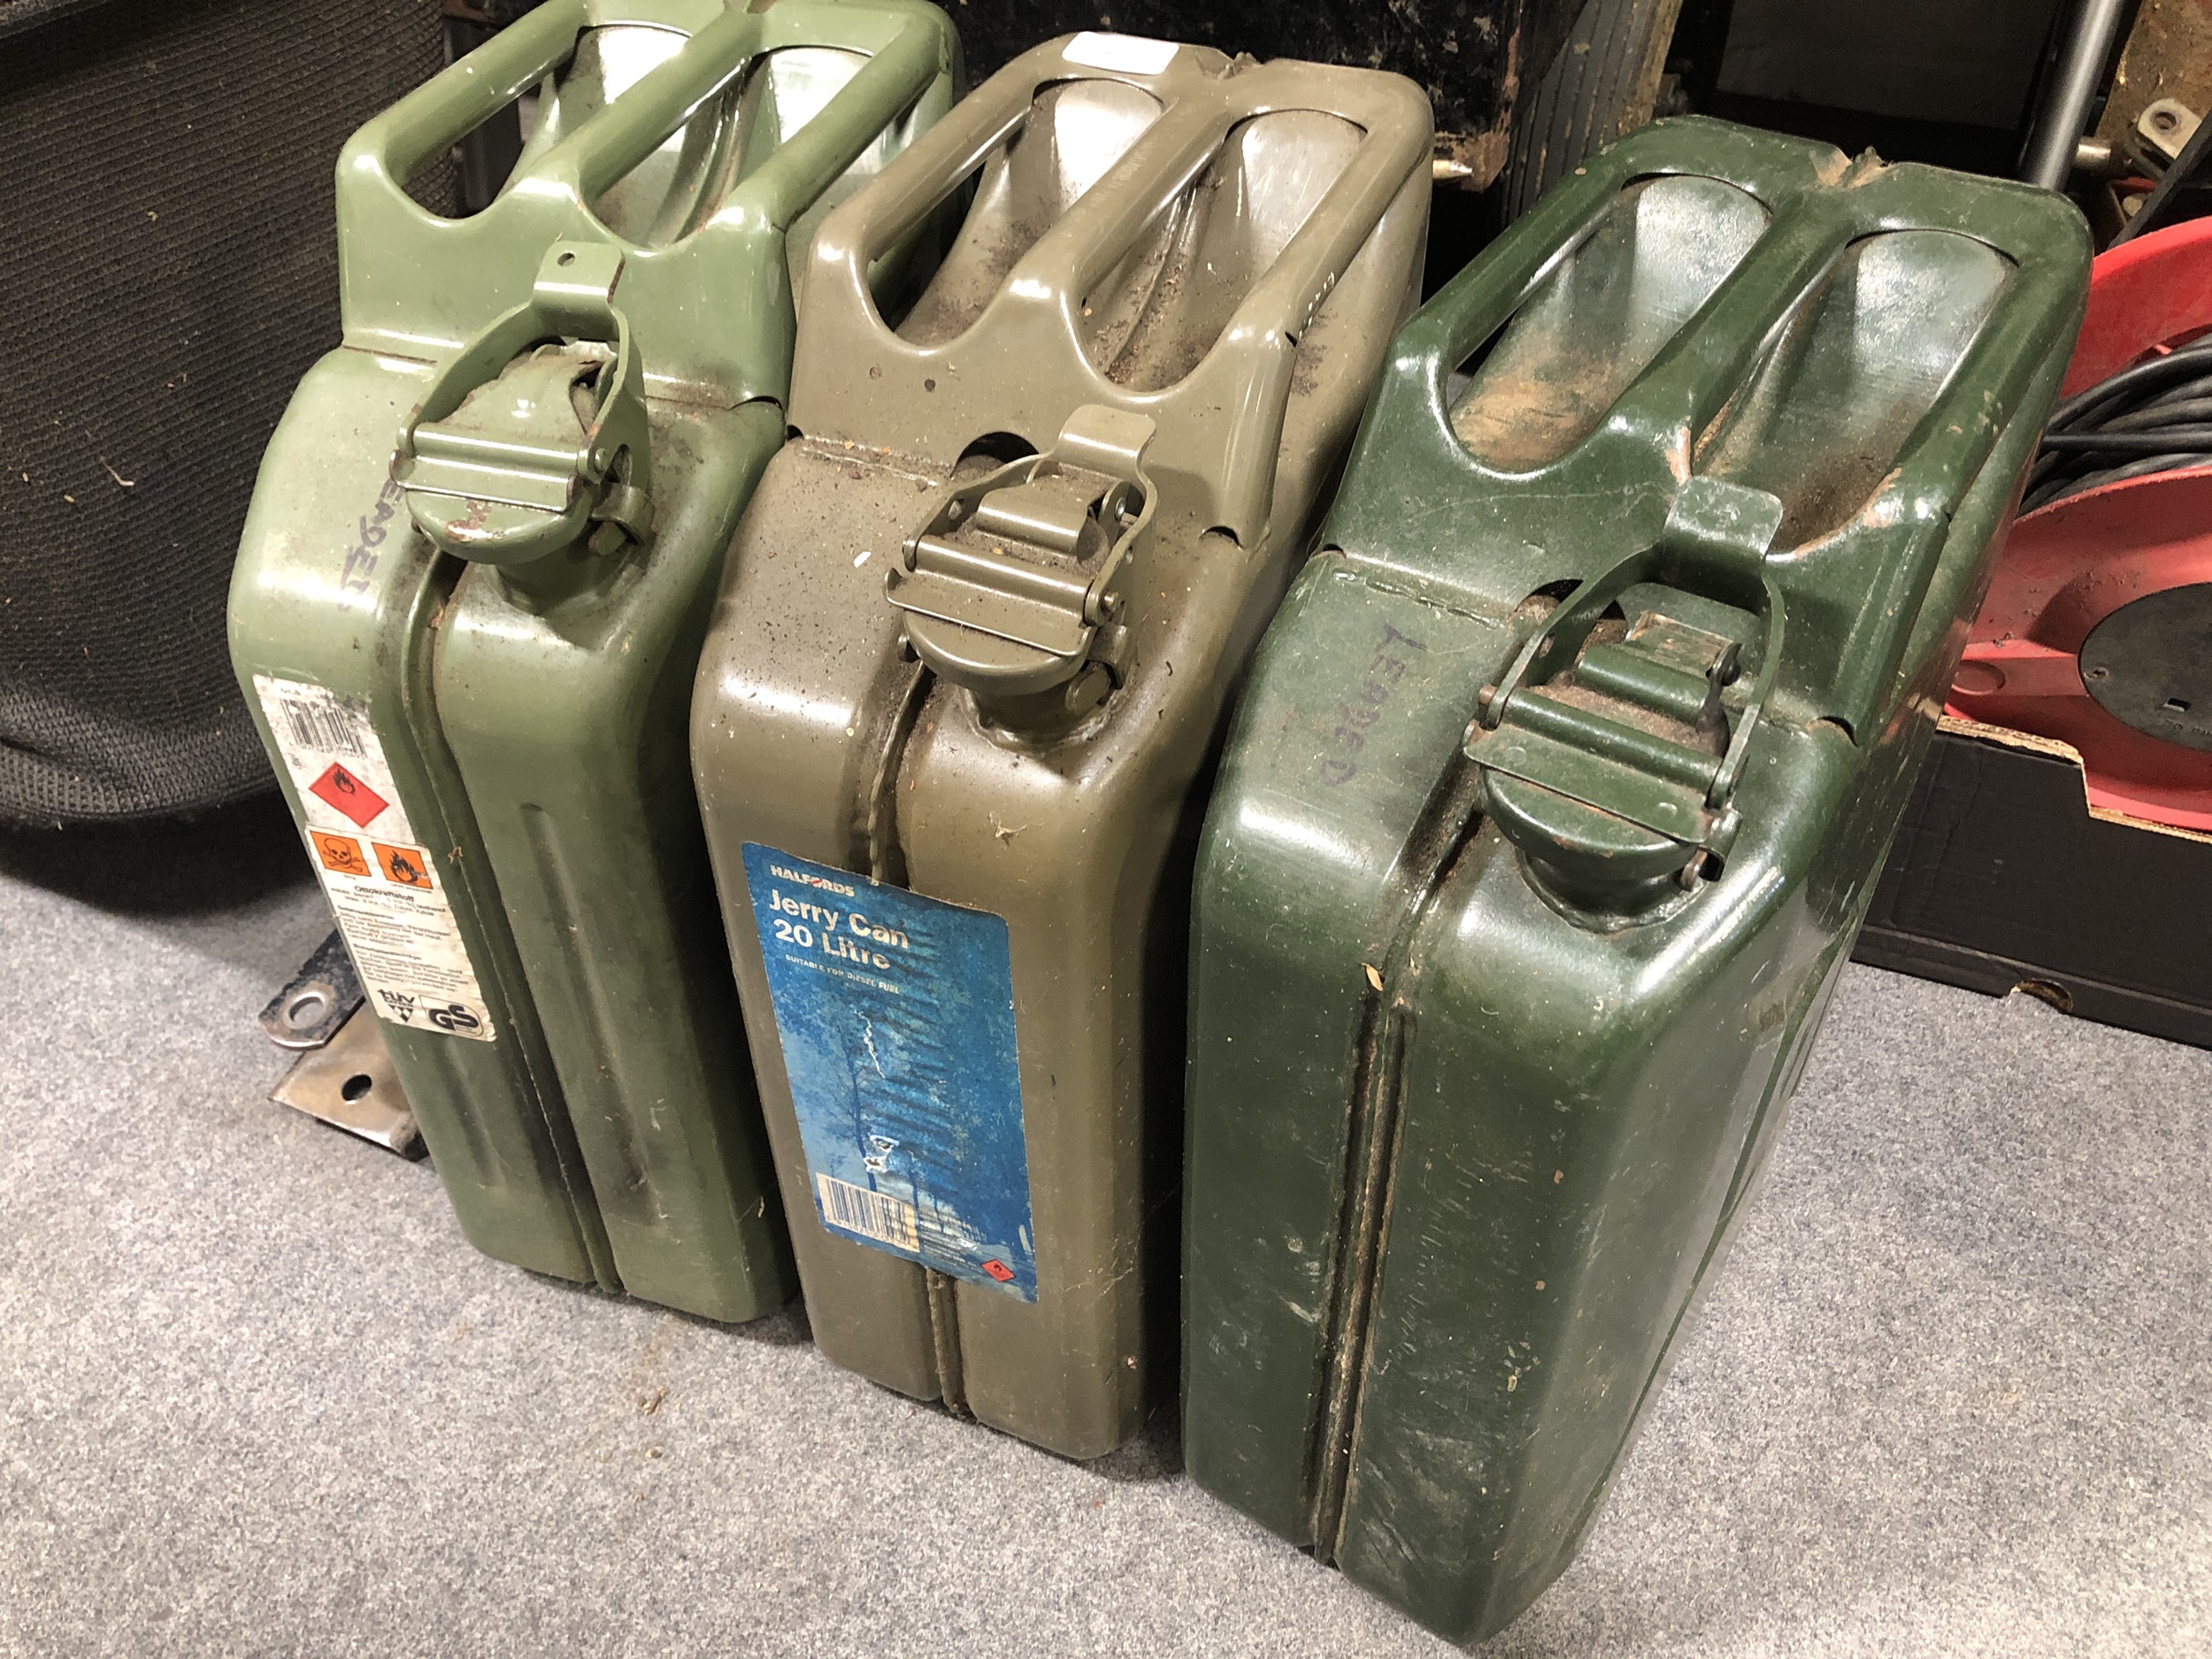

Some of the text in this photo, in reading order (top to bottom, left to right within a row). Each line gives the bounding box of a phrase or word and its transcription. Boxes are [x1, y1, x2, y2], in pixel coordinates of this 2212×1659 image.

[770, 864, 855, 897] HALFORDS
[769, 888, 909, 949] Jerry Can
[773, 918, 891, 970] 20 Litre
[878, 981, 901, 995] FUEL
[428, 1004, 479, 1032] GS
